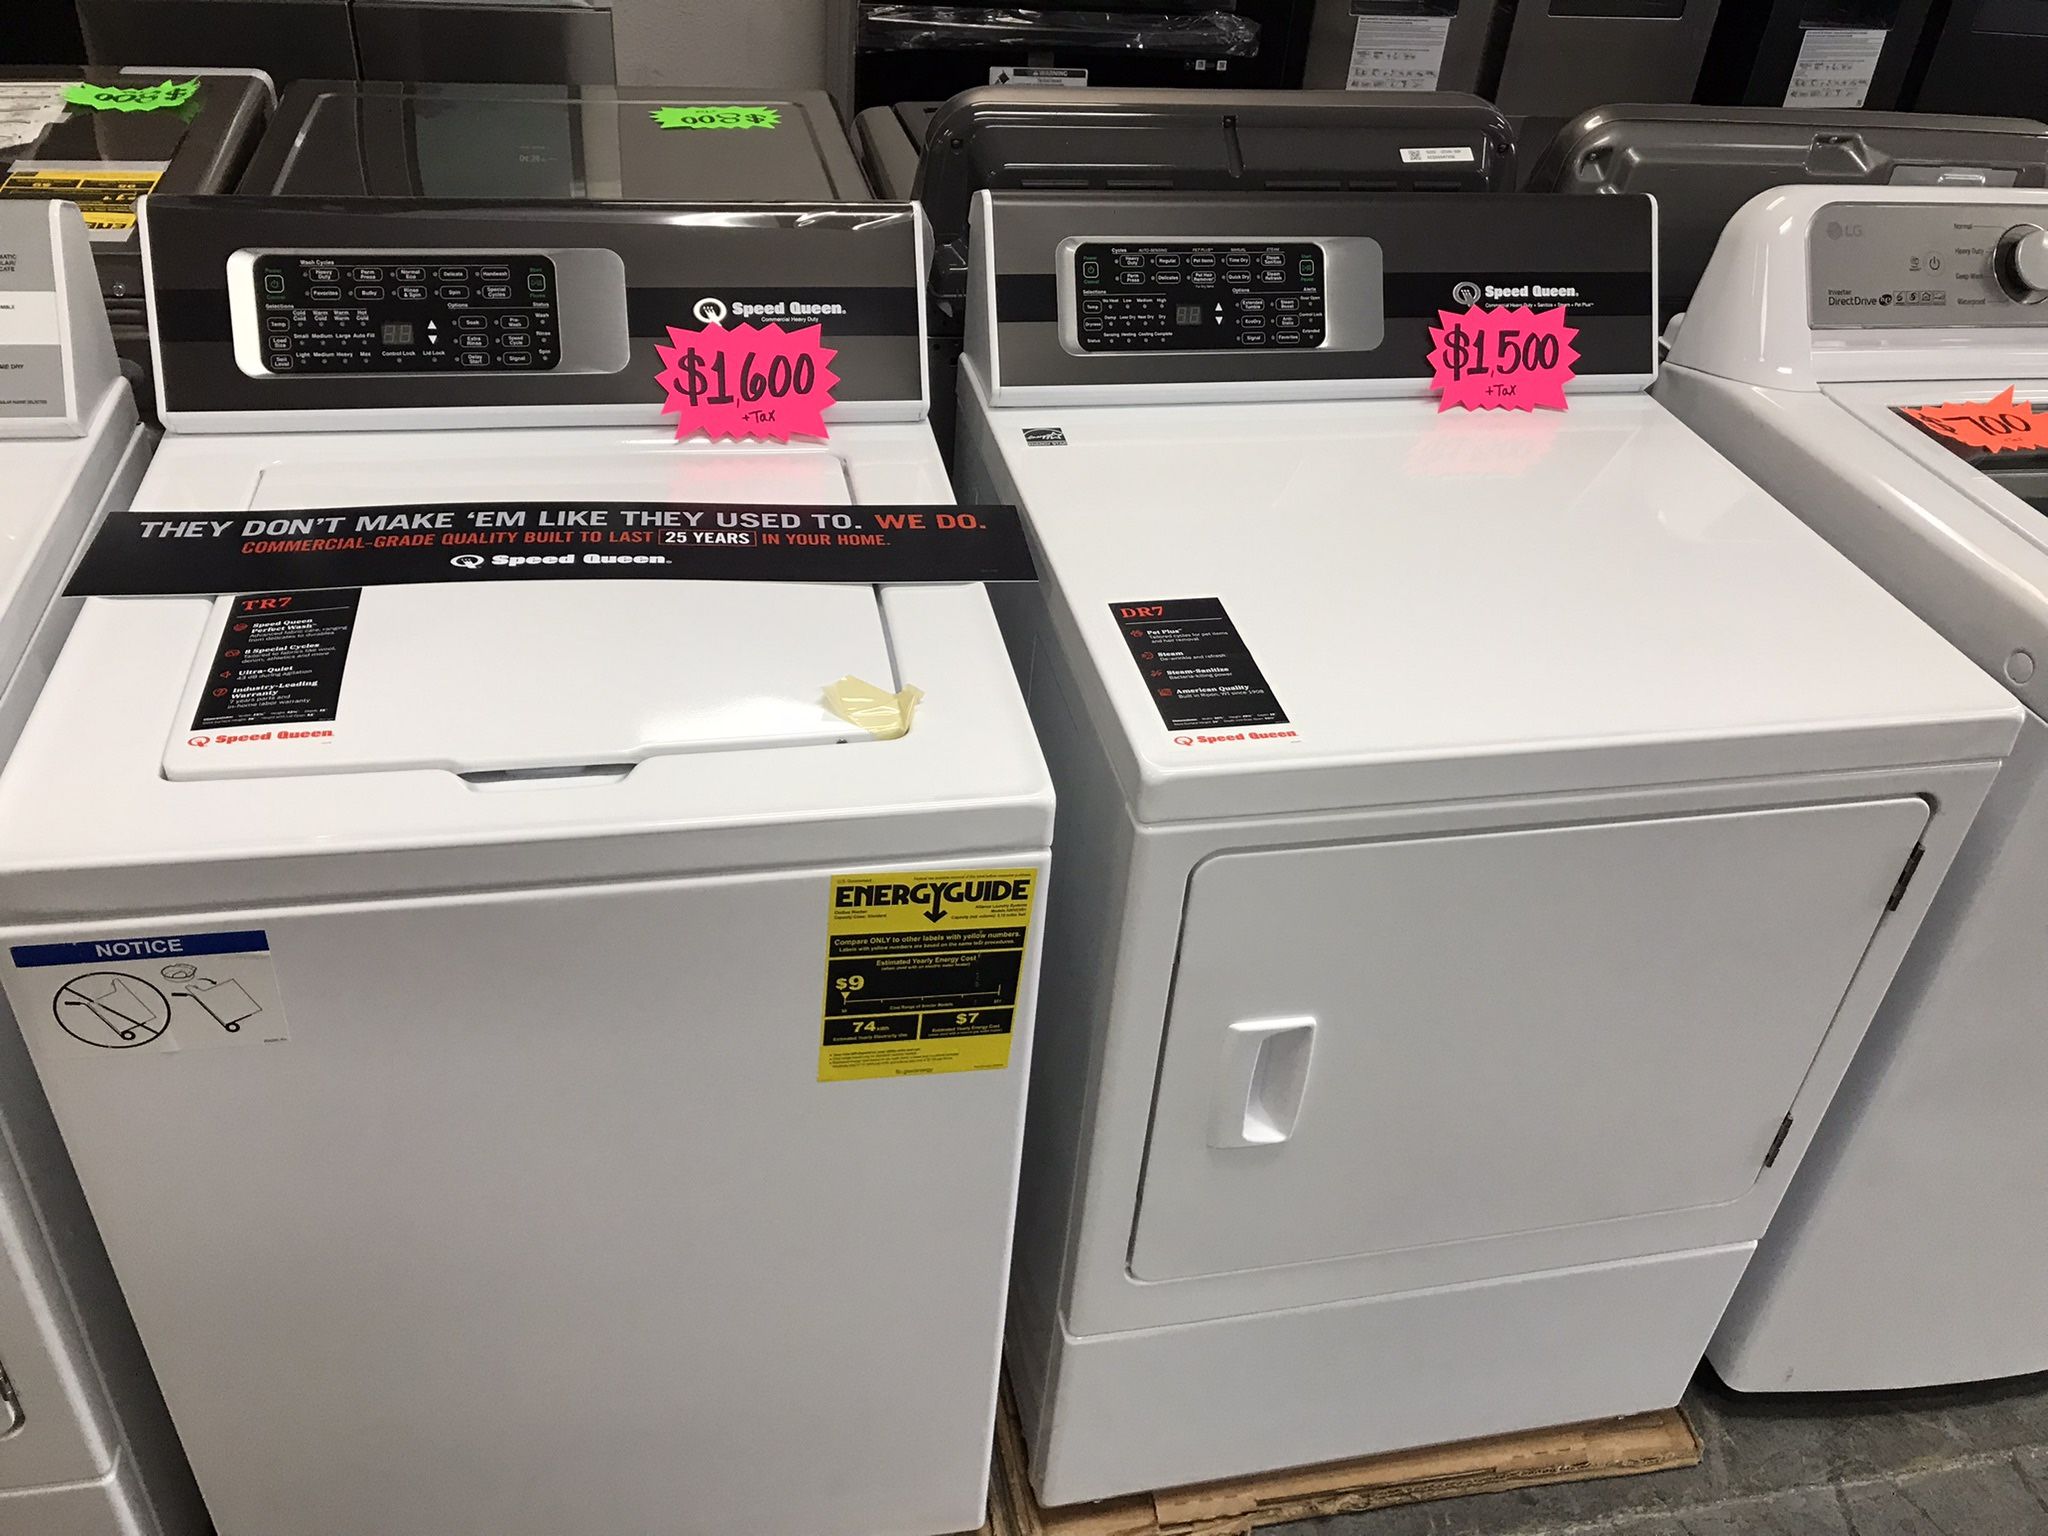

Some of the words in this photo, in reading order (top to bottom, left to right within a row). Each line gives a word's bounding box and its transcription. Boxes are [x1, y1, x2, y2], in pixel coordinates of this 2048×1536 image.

[681, 113, 766, 124] $800
[1846, 226, 1862, 237] LG
[1485, 285, 1529, 299] Speed
[732, 301, 785, 317] Speed
[1443, 323, 1559, 381] $1,500
[674, 347, 815, 408] $1,600
[1919, 413, 2032, 436] $700
[139, 521, 234, 538] THEY
[241, 516, 346, 537] DON'T
[355, 512, 455, 532] MAKE
[538, 510, 608, 527] LIKE
[620, 511, 704, 527] THEY
[716, 512, 801, 529] USED
[810, 513, 862, 530] TO.
[874, 513, 926, 529] WE
[935, 514, 987, 530] DO.
[241, 533, 435, 554] COMMERCIAL-GRADE
[441, 531, 519, 545] QUALITY
[524, 531, 578, 544] BUILT
[581, 531, 602, 543] TO
[610, 531, 654, 543] LAST
[665, 531, 687, 543] 25
[693, 532, 750, 544] YEARS
[762, 533, 780, 544] IN
[786, 533, 831, 545] YOUR
[837, 534, 891, 546] HOME.
[491, 554, 575, 567] Speed
[241, 597, 293, 611] TR7
[1120, 606, 1163, 619] DR7
[252, 626, 285, 634] Perfect
[252, 645, 288, 654] Special
[289, 643, 320, 651] Cycles
[238, 666, 293, 676] Ultra-Quiet
[1166, 667, 1230, 675] Steam-Sanitize
[233, 680, 319, 693] Industry-Leading
[231, 690, 279, 699] Warranty
[215, 732, 272, 744] Speed
[1196, 733, 1245, 744] Speed
[836, 880, 1031, 908] ENERGYGUIDE
[834, 938, 868, 946] Compare
[963, 933, 986, 942] yellow
[95, 938, 184, 957] NOTICE
[912, 957, 932, 965] Yearly
[934, 956, 958, 964] Energy
[835, 975, 865, 991] $9
[956, 1012, 980, 1025] $7
[853, 1021, 876, 1033] 74
